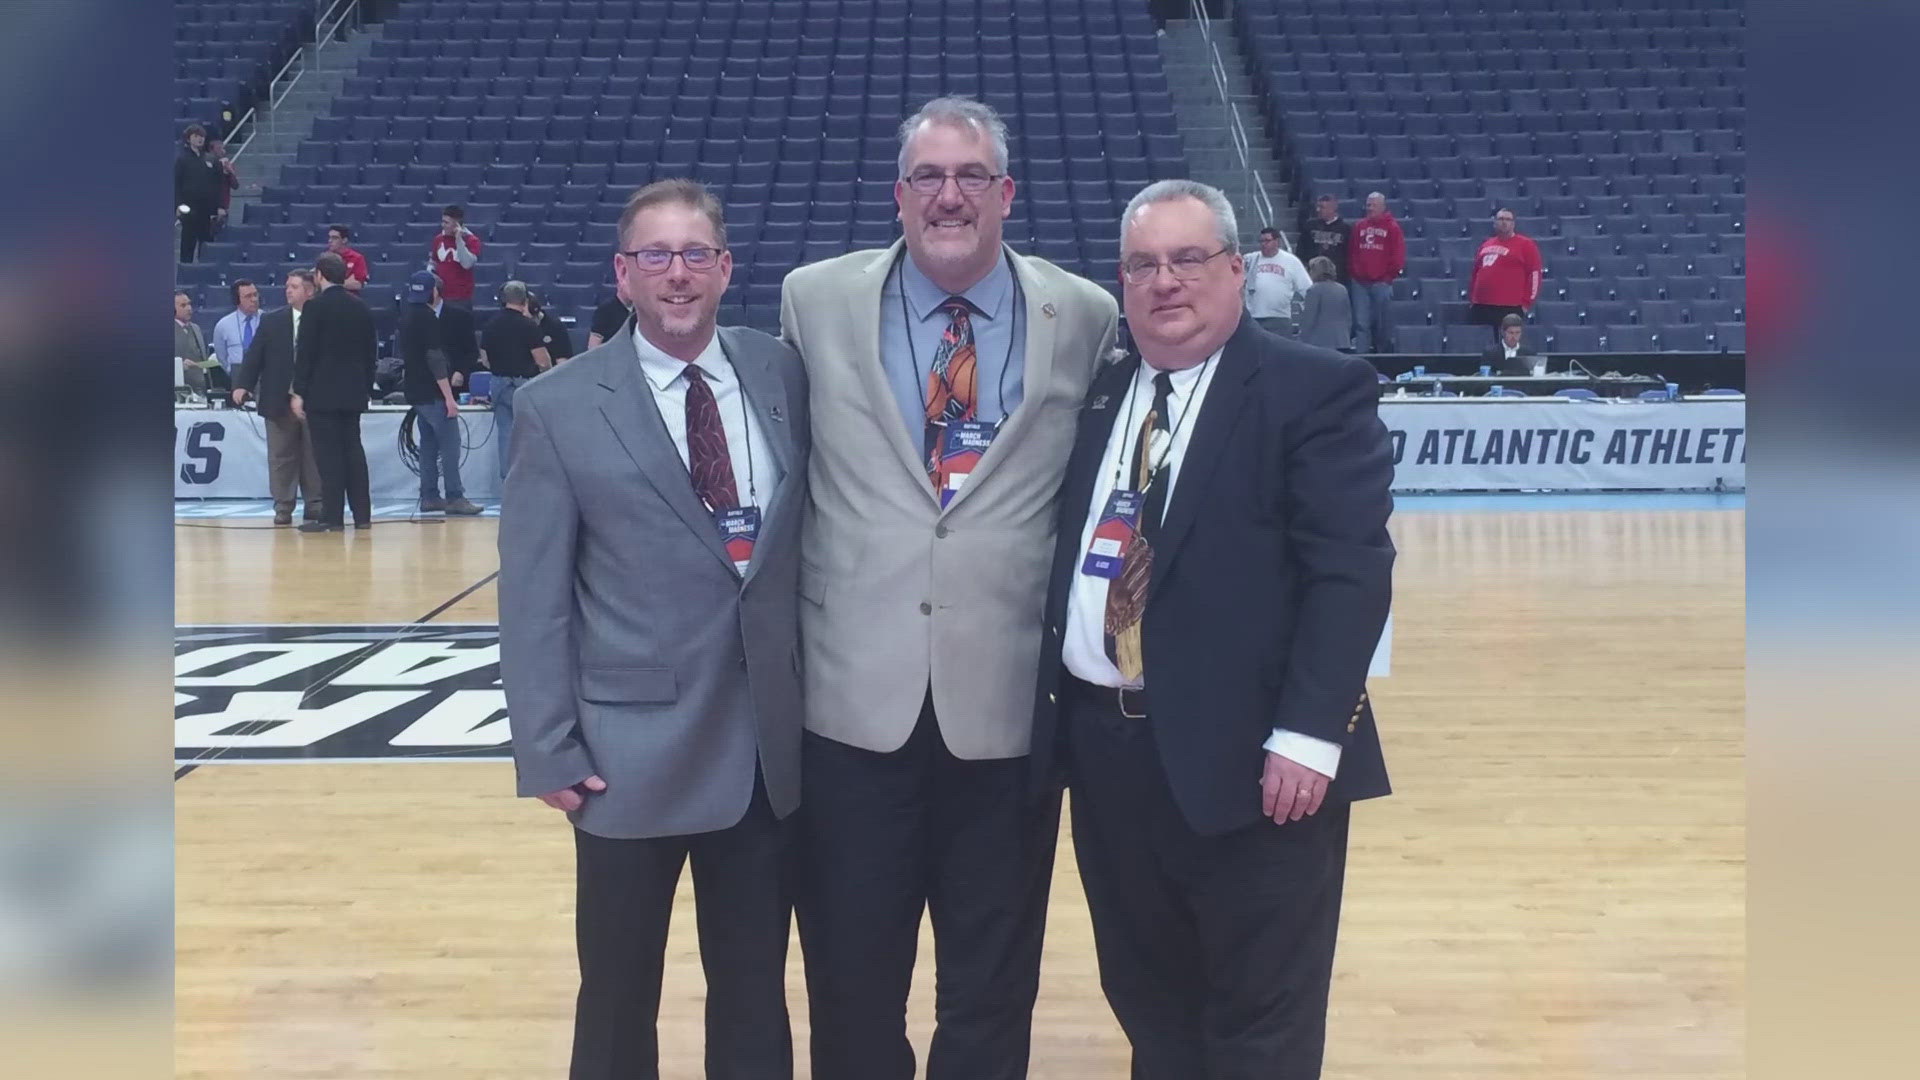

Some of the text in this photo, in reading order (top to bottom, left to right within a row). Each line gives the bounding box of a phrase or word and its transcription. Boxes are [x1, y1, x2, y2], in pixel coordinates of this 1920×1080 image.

[960, 431, 982, 440] MARCH
[962, 439, 992, 447] MADNESS
[1416, 429, 1595, 465] ATLANTIC
[1603, 428, 1745, 465] ATHLET
[175, 421, 226, 485] S
[728, 524, 755, 533] MADNESS
